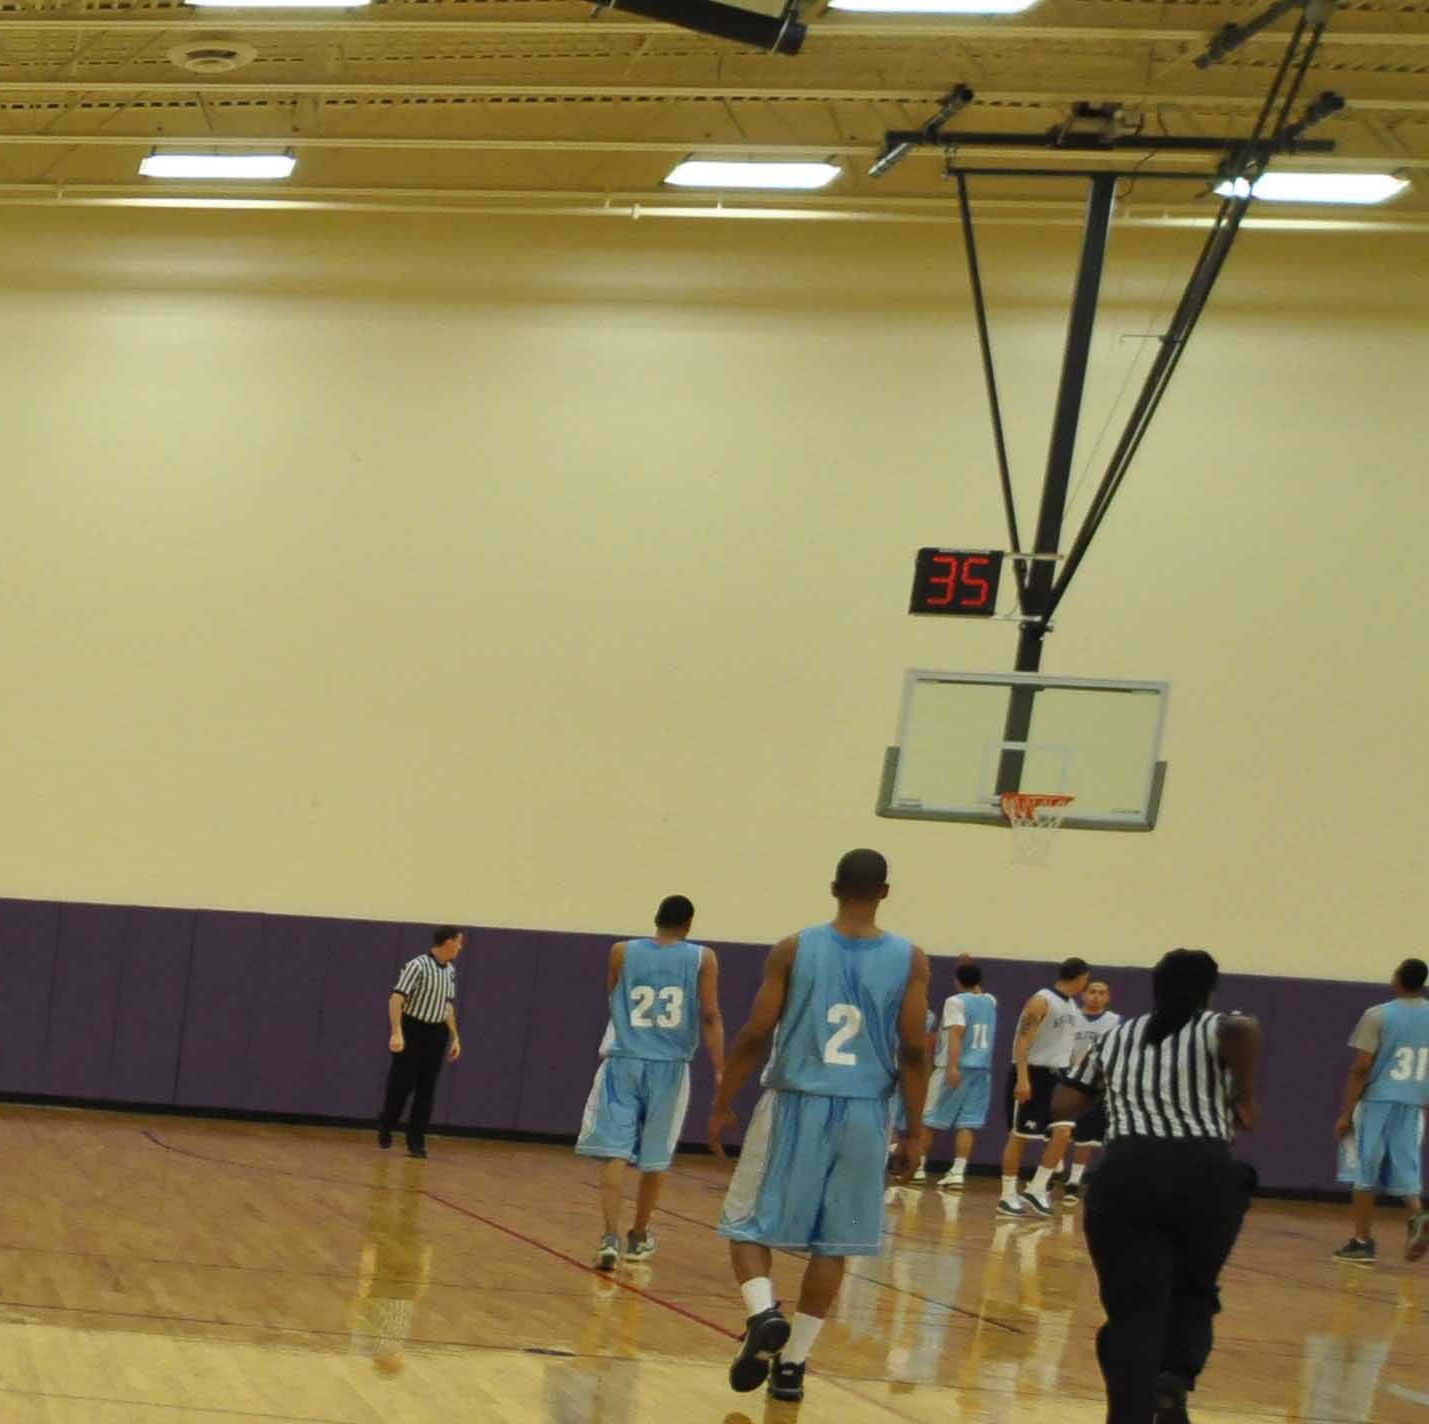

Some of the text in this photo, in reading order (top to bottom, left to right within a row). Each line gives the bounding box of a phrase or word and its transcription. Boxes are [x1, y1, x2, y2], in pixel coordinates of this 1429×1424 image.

[926, 555, 990, 606] 35
[630, 985, 684, 1028] 23
[823, 1002, 862, 1066] 2
[970, 1023, 988, 1049] 11
[1388, 1046, 1429, 1081] 31
